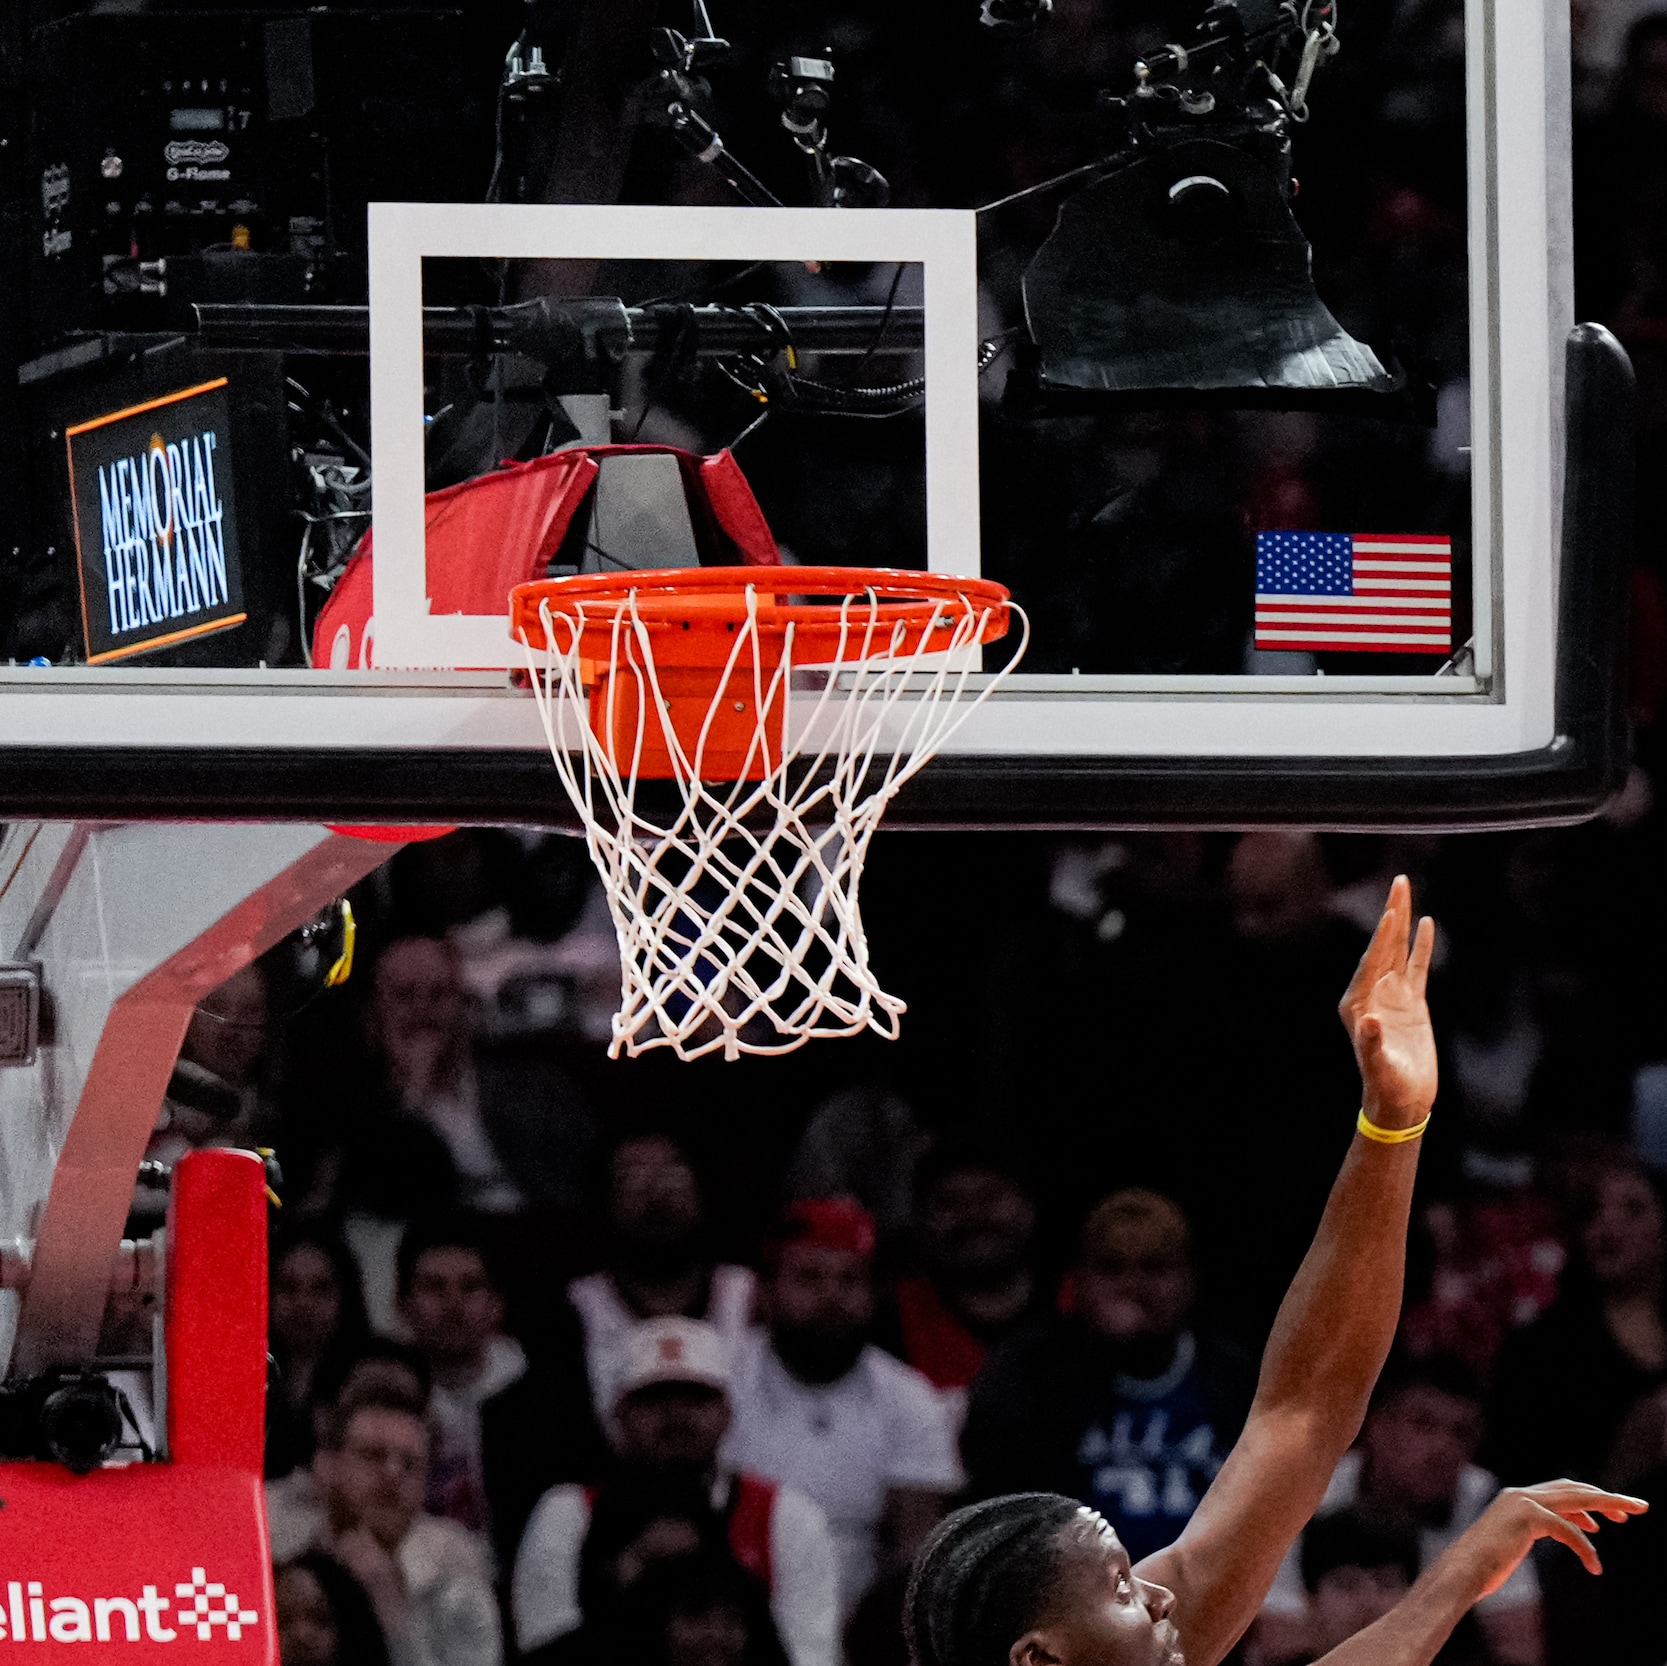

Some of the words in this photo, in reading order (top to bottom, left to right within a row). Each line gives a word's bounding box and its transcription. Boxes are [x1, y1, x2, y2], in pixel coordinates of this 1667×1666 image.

[99, 432, 223, 550] MEMORIAL
[104, 518, 228, 635] HERMANN
[0, 1581, 177, 1643] liant
